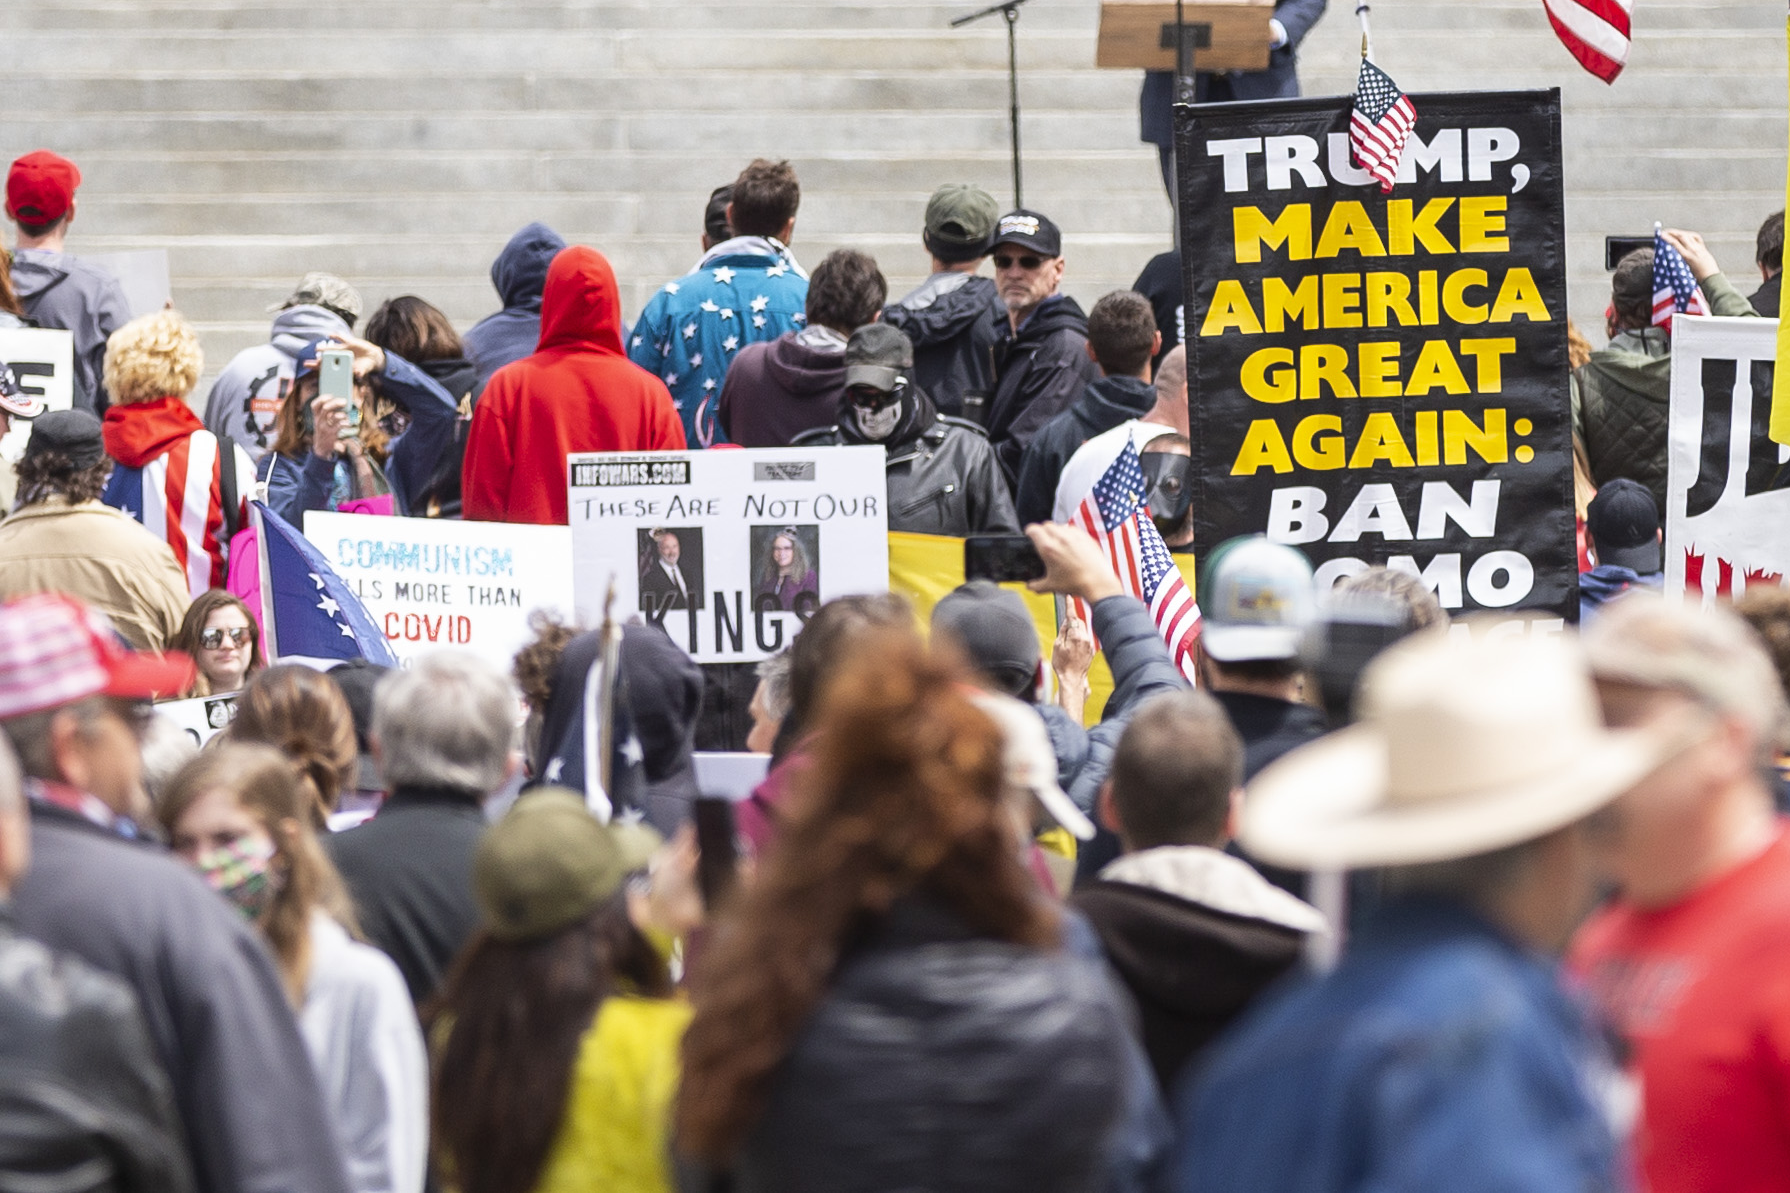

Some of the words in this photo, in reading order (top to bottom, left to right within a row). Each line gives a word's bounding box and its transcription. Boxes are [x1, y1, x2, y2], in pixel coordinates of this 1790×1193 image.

[1233, 196, 1511, 264] MAKE
[1200, 268, 1552, 337] AMERICA
[1240, 337, 1516, 404] GREAT
[1230, 409, 1535, 476] AGAIN:
[576, 463, 687, 486] INFOWARS.COM
[575, 497, 661, 520] THESE
[666, 495, 721, 519] ARE
[743, 494, 808, 518] NOT
[813, 494, 877, 520] OUR
[1267, 480, 1502, 546] BAN
[338, 538, 513, 576] COMMUNISM
[395, 581, 451, 604] MORE
[468, 586, 521, 607] THAN
[384, 612, 471, 643] COVID
